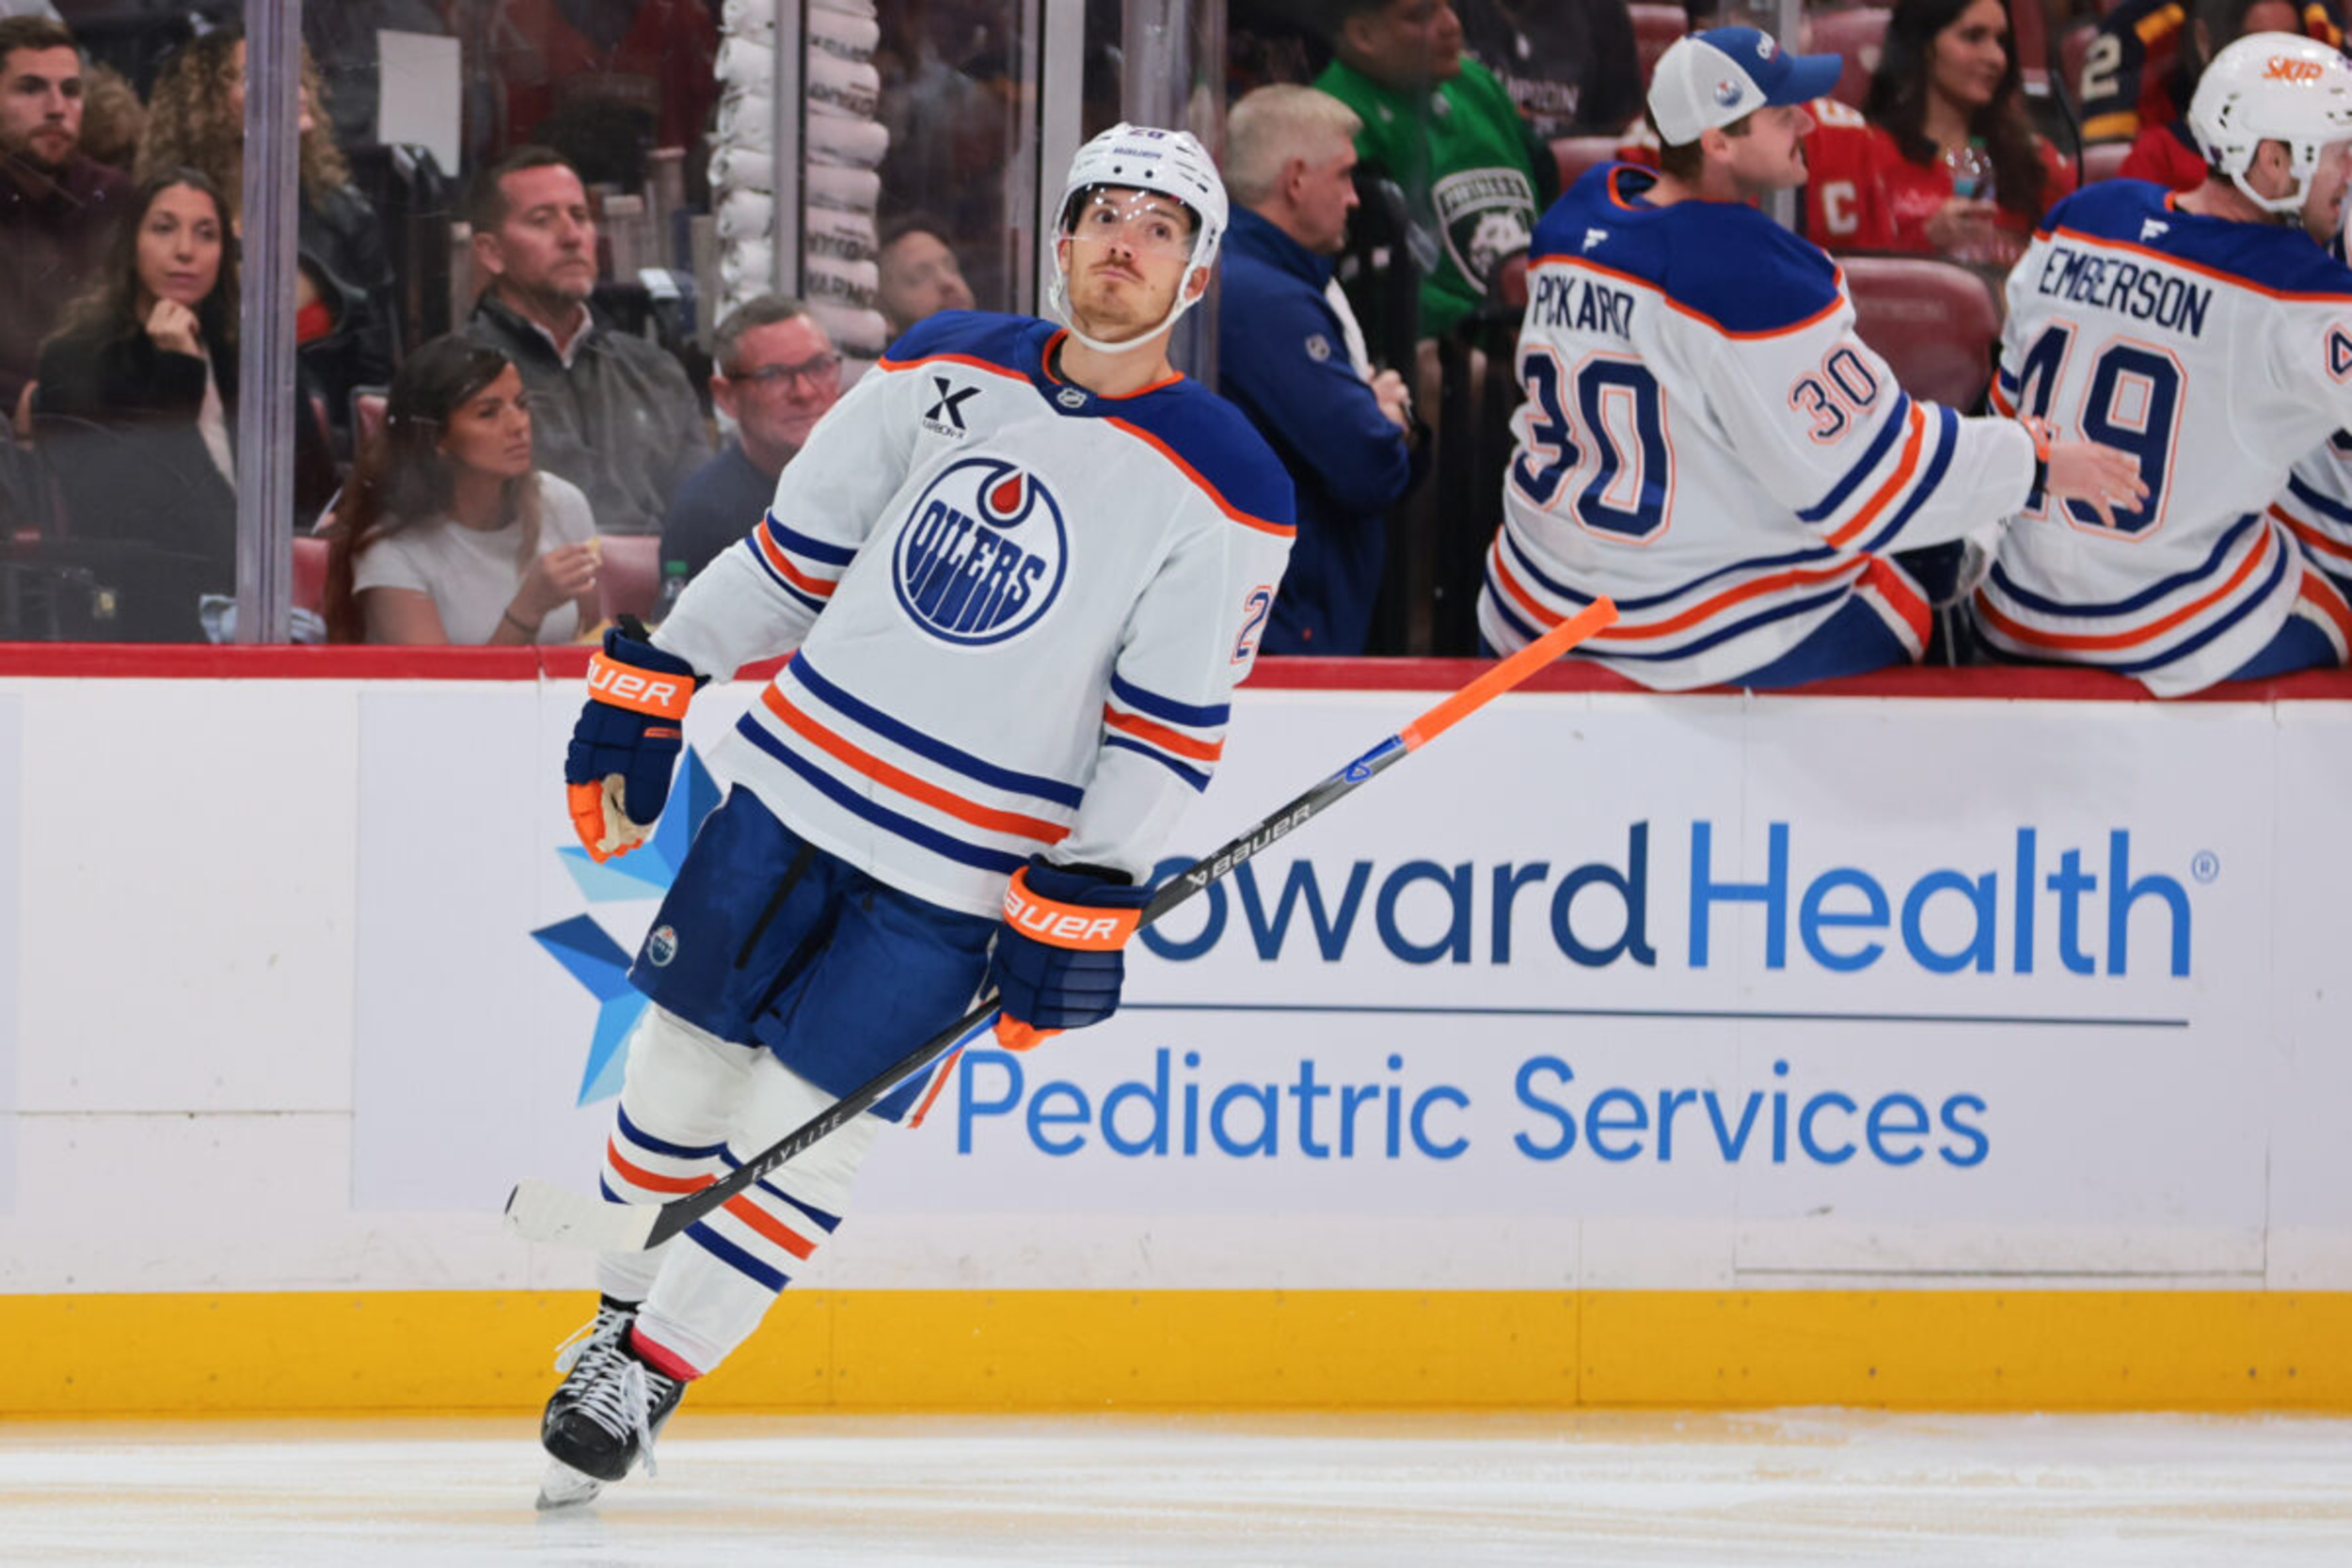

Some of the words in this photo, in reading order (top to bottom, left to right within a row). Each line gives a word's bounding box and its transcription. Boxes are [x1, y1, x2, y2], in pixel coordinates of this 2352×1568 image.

[1822, 180, 1859, 234] C
[2038, 246, 2213, 339] EMBERSON
[1788, 343, 1879, 446] 30
[1511, 344, 1677, 546] 30
[905, 499, 1047, 635] OILERS
[1212, 802, 1311, 879] BAUER
[1005, 891, 1120, 941] AUER
[1138, 820, 1657, 969] oward
[752, 1112, 843, 1182] FLYLITE
[957, 1047, 1471, 1160] Pediatric
[1514, 1054, 1991, 1168] Services
